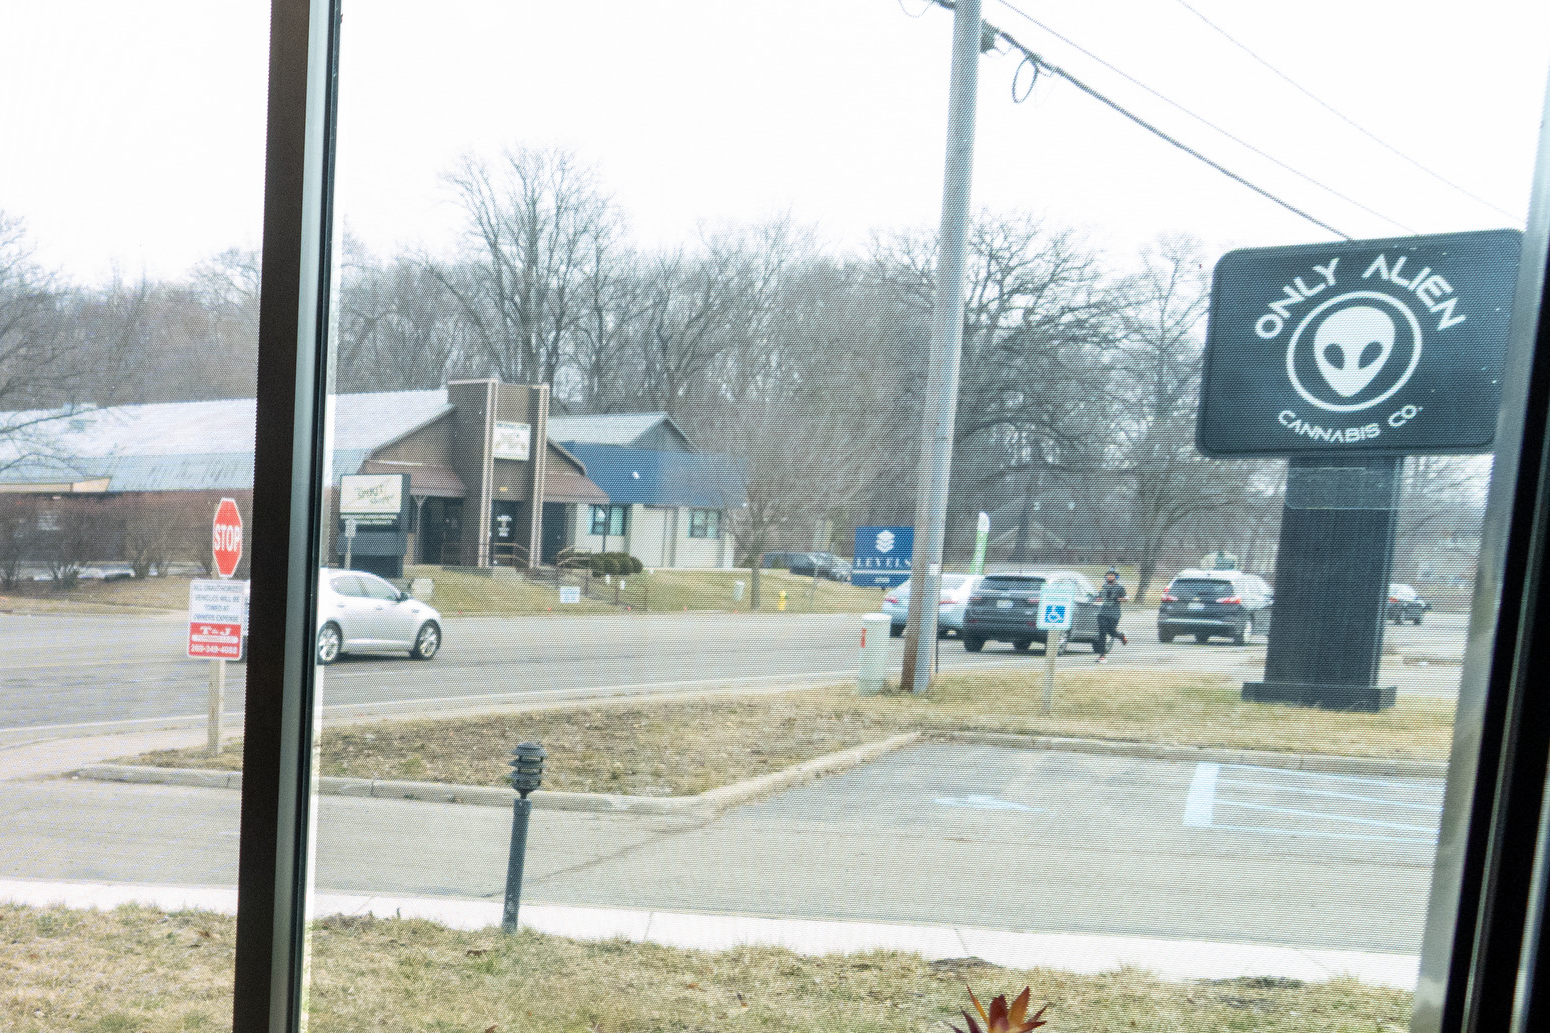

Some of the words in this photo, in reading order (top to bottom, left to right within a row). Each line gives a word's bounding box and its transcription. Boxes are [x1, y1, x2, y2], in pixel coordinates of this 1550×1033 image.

[1254, 257, 1340, 339] ONLY
[1361, 253, 1467, 332] ALIEN
[1278, 409, 1381, 443] CANNABIS
[1388, 404, 1424, 428] CO.
[214, 525, 241, 552] STOP
[856, 557, 911, 568] LEVELS
